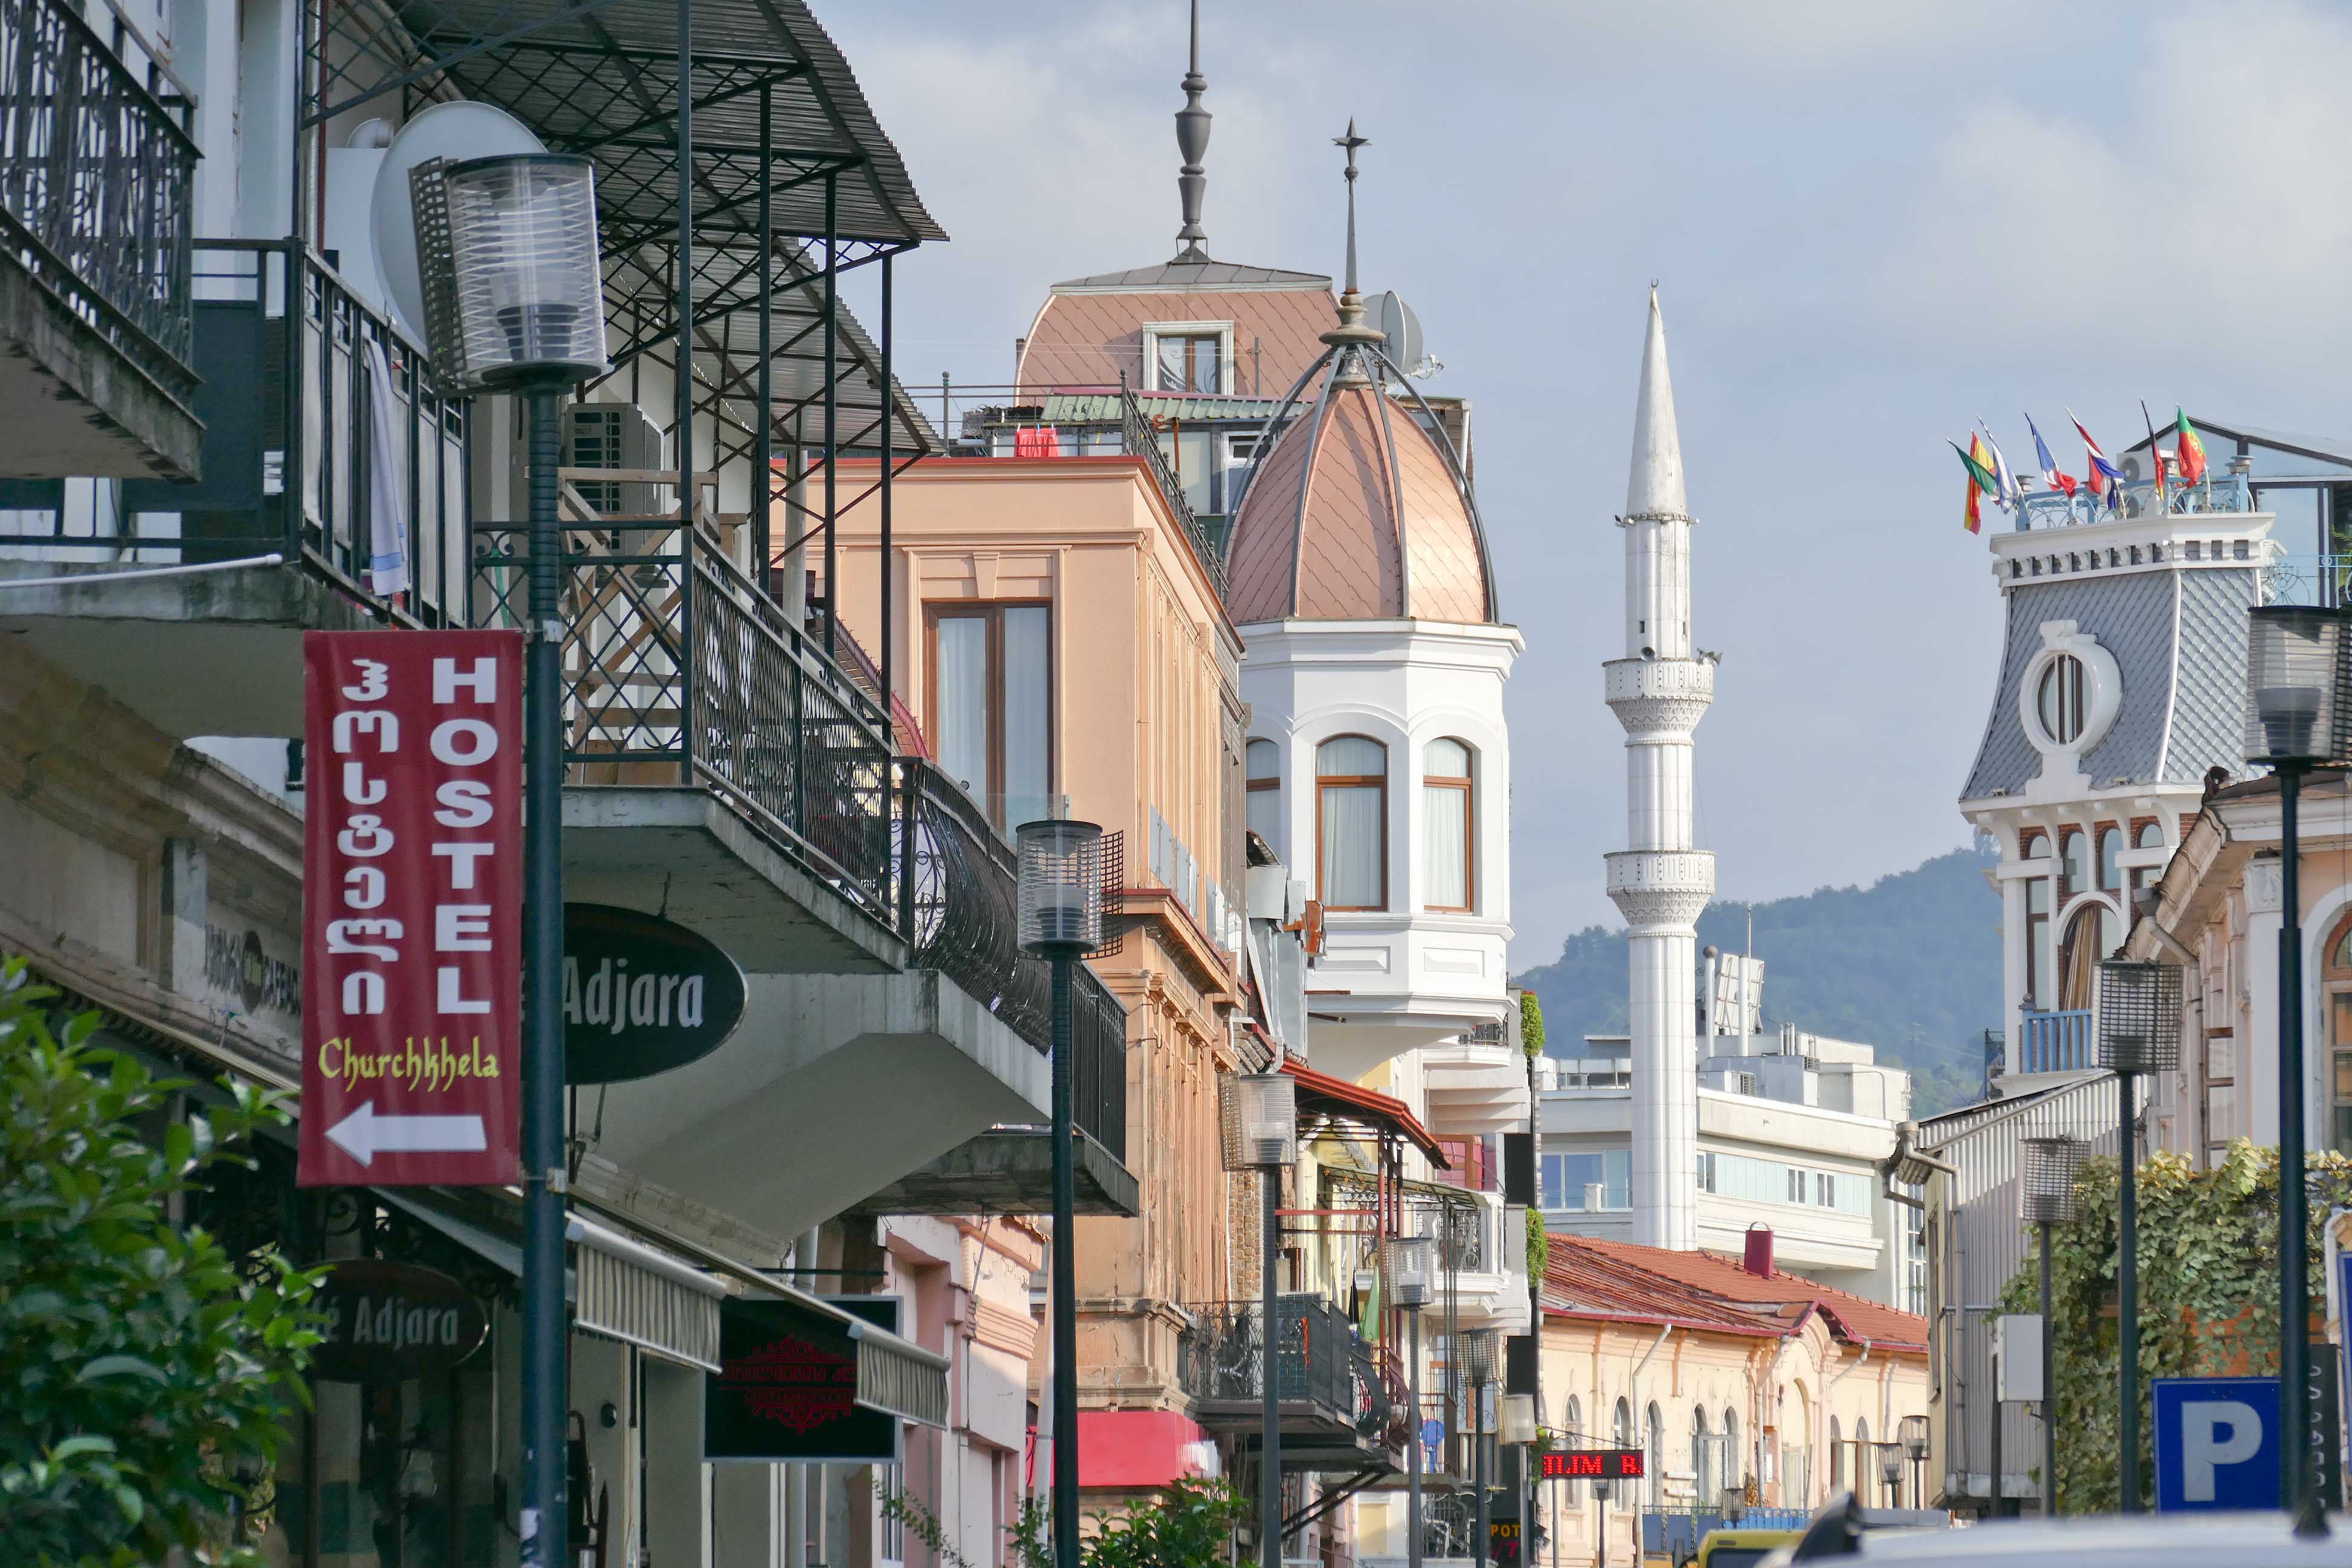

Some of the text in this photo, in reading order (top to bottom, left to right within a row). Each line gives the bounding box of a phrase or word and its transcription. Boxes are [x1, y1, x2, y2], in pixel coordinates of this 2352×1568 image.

[325, 658, 403, 1015] ჰოსტელი
[430, 657, 498, 1015] HOSTEL
[562, 956, 704, 1035] Adjara
[318, 1036, 500, 1092] Churchkhela
[353, 1296, 459, 1353] Adjara
[2181, 1400, 2263, 1502] P
